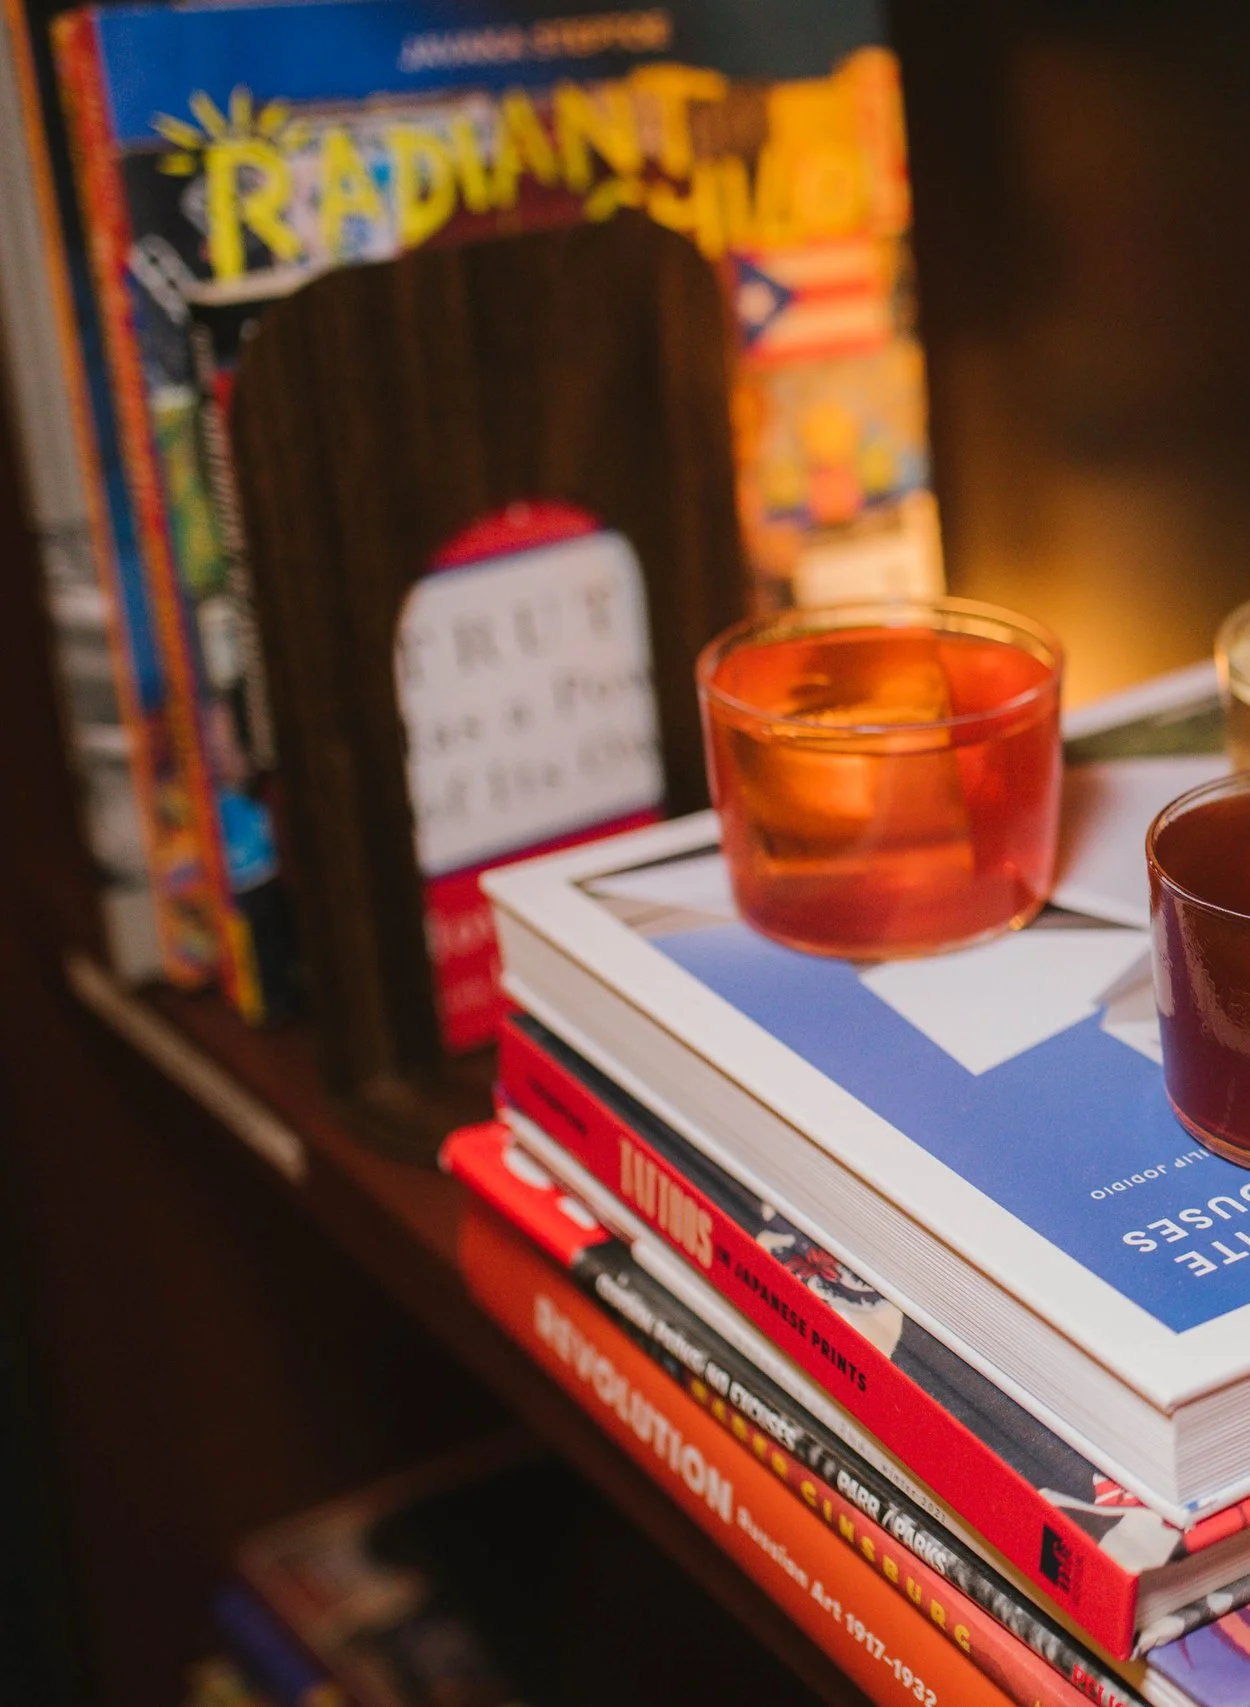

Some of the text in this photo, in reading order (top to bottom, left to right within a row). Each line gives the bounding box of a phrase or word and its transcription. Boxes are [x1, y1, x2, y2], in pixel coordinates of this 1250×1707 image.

[203, 64, 729, 283] RADIANT
[1090, 1148, 1211, 1200] ILIP JODIDIO
[734, 1262, 809, 1338] JAPANESE
[811, 1329, 868, 1393] PRINTS
[533, 1295, 734, 1525] REVOLUTION
[810, 1579, 843, 1623] Art
[800, 1479, 972, 1655] GINSBURG
